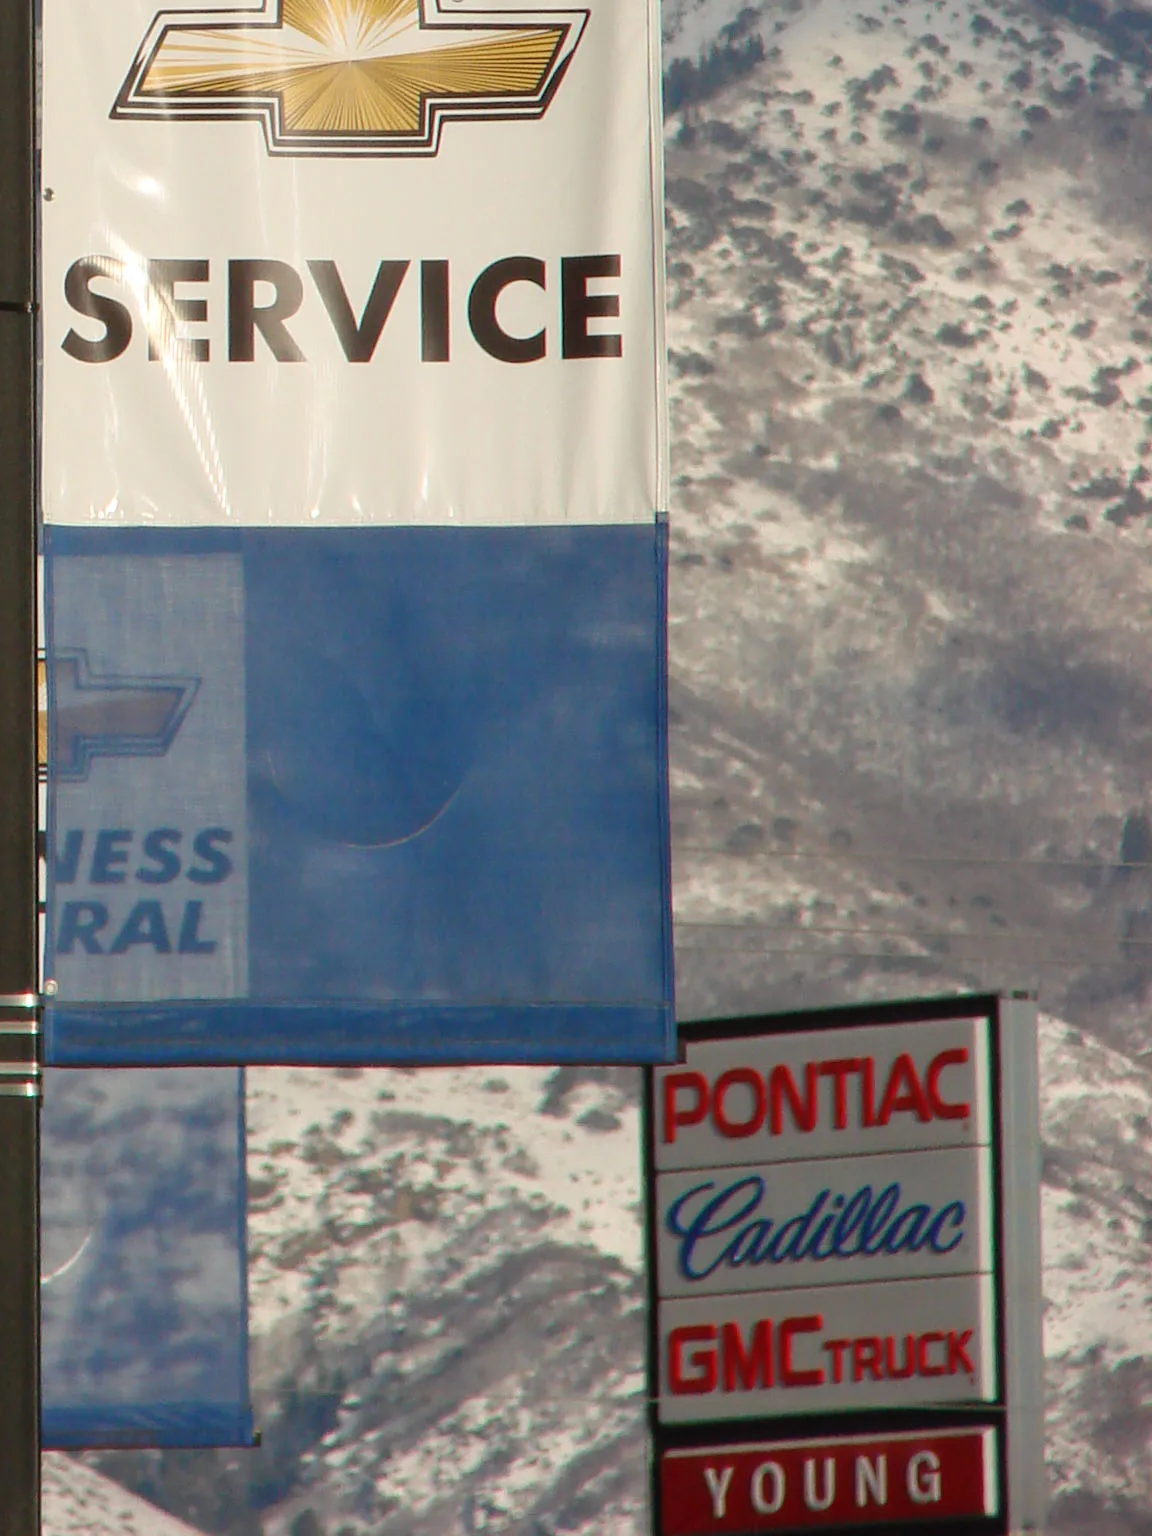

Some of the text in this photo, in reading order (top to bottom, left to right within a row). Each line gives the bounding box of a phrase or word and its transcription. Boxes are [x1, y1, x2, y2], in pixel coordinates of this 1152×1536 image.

[61, 254, 623, 364] SERVICE
[662, 1047, 971, 1144] PONTIAC
[666, 1176, 966, 1280] Cadillac
[704, 1450, 943, 1519] YOUNG
